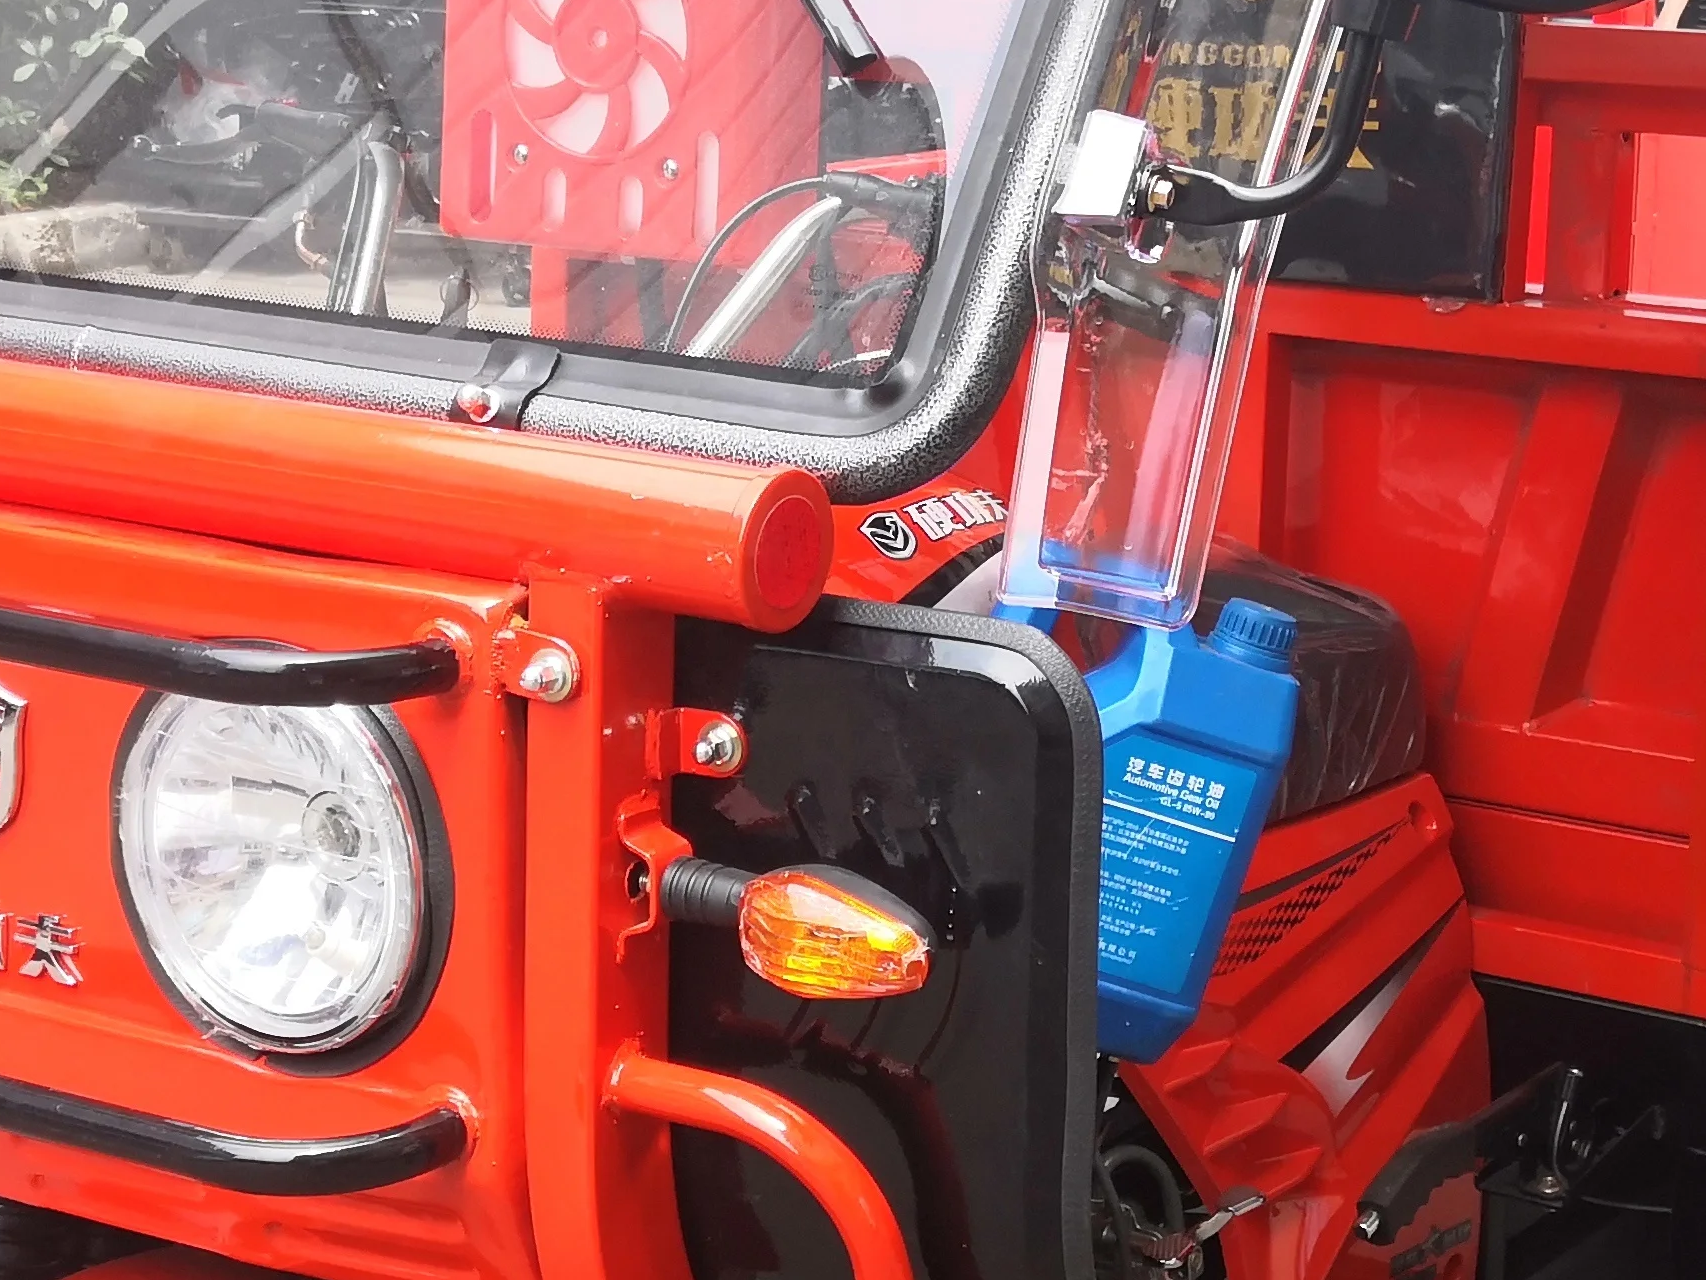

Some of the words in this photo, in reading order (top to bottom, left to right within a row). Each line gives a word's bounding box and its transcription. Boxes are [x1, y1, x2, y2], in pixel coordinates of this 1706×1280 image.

[901, 488, 1009, 542] 硬功夫
[1121, 772, 1180, 798] Automotive
[1179, 789, 1205, 805] Gear
[1204, 798, 1221, 810] Oil
